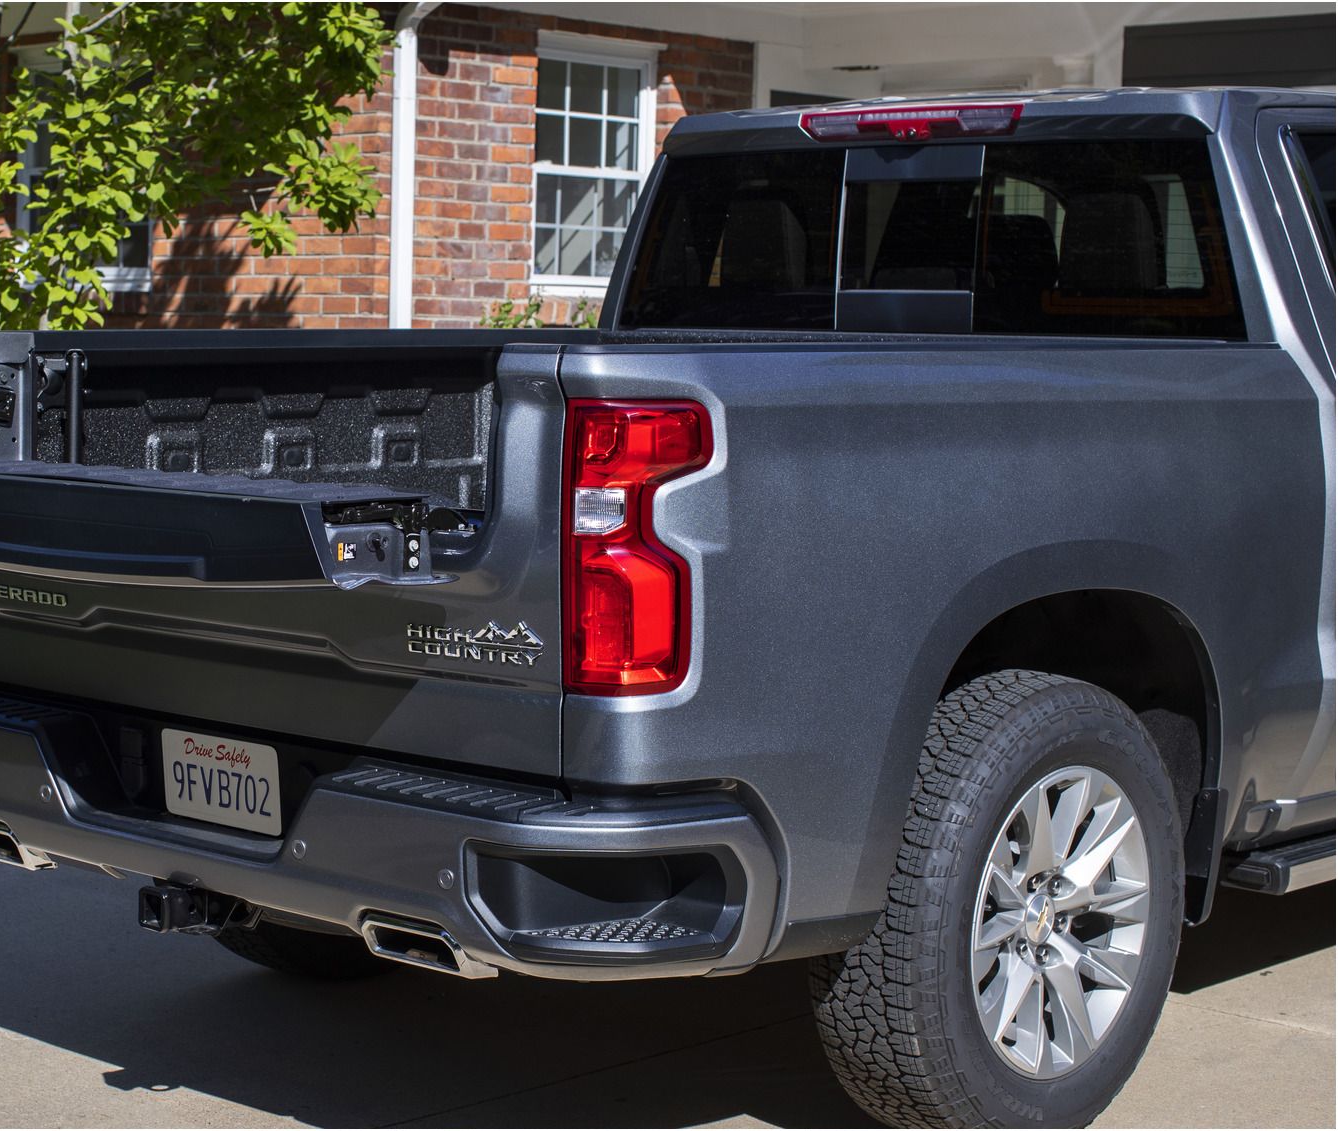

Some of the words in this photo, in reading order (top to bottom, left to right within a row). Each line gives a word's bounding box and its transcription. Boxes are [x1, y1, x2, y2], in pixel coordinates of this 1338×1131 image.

[406, 623, 475, 643] HIGH
[407, 640, 543, 666] COUNTRY
[184, 737, 213, 758] Drive
[215, 744, 251, 769] Safely
[172, 760, 271, 817] 9FVB702
